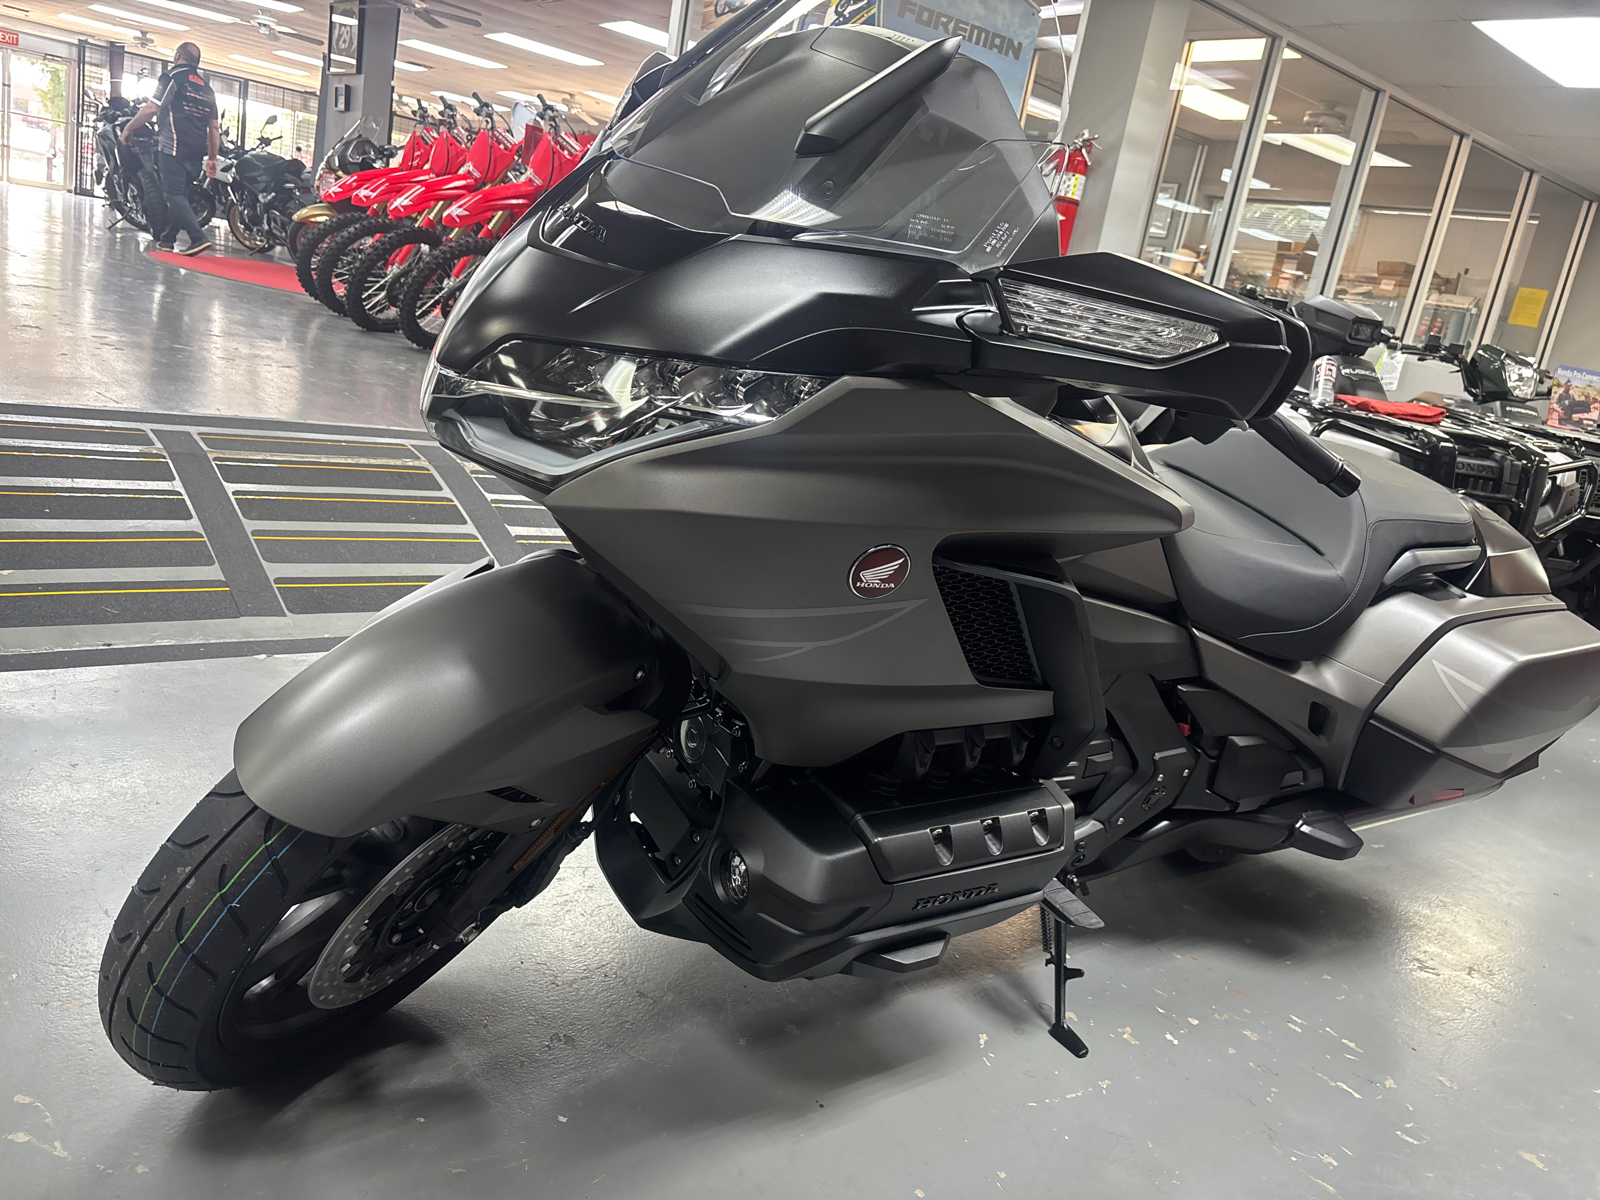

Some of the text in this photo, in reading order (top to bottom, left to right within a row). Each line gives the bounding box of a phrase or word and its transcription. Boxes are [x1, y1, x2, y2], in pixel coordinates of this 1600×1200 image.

[0, 31, 18, 45] EXIT
[897, 0, 1023, 61] FOREMAN
[1557, 367, 1573, 377] Honda
[911, 882, 999, 911] HONDA
